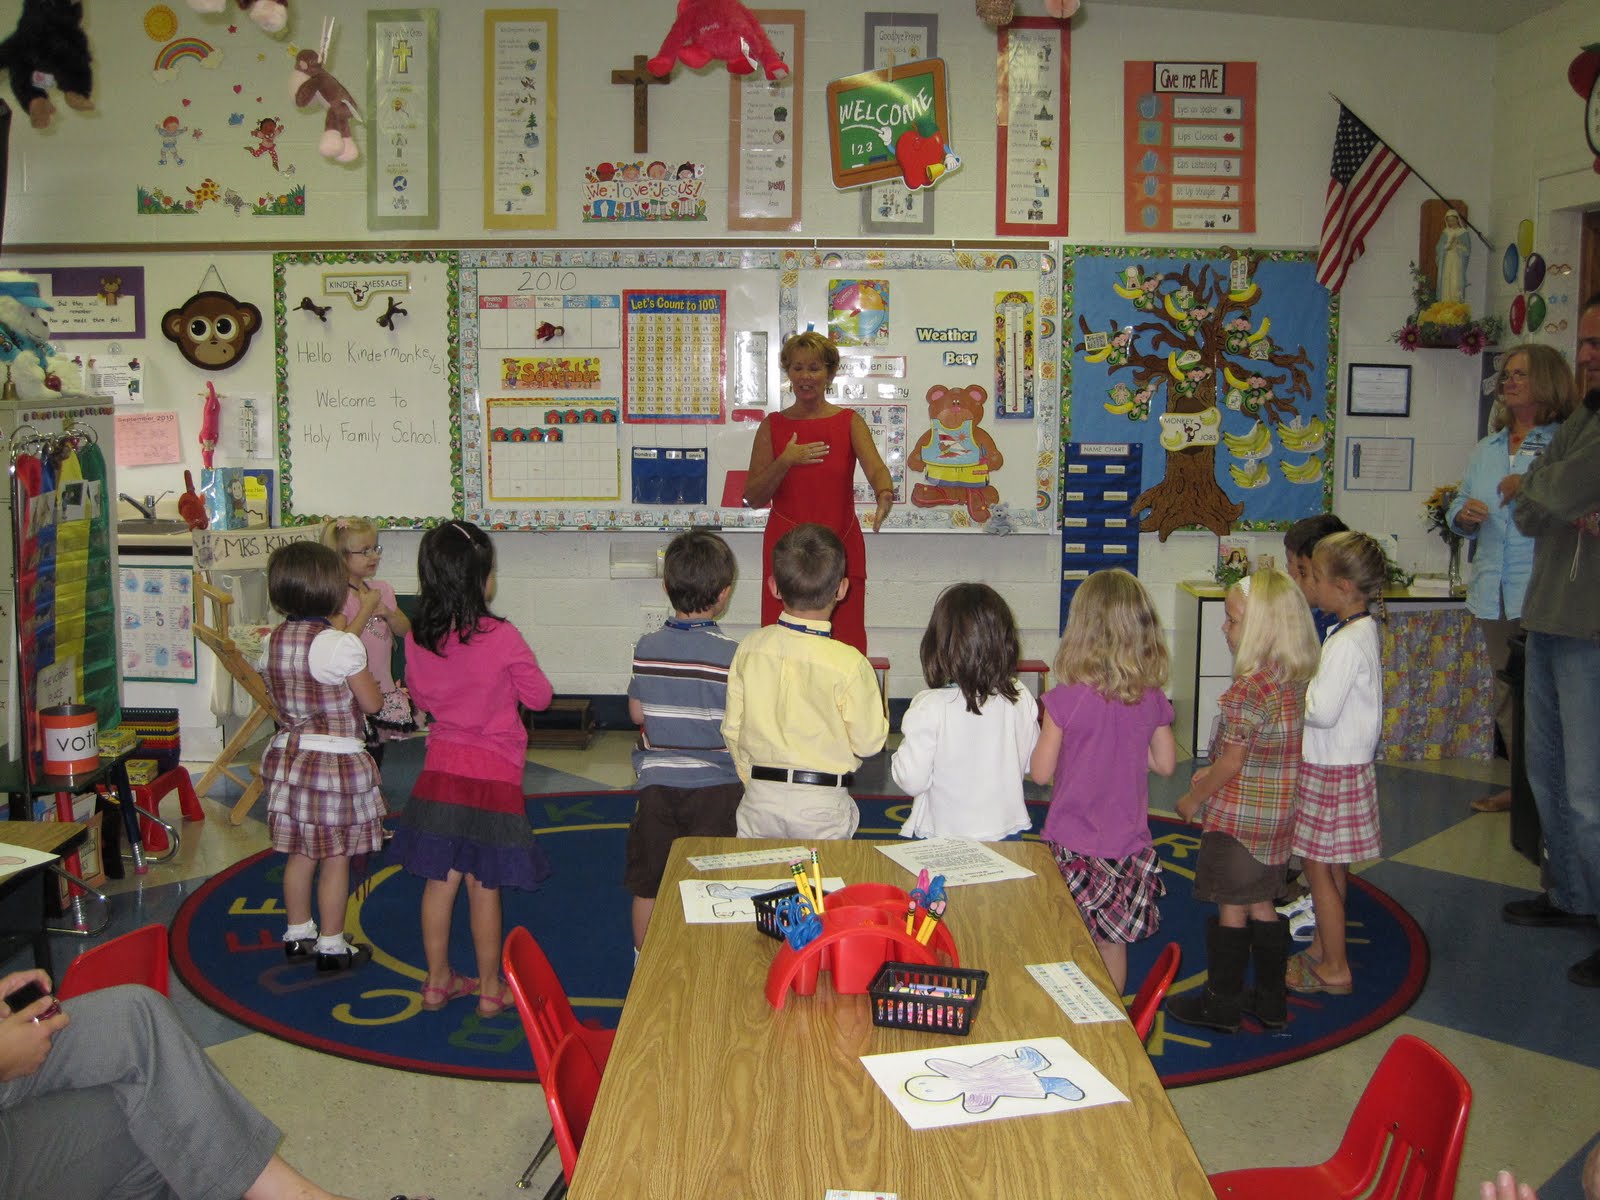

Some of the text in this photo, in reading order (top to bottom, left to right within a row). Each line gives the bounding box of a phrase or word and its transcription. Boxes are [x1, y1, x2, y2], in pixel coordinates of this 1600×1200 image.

[880, 31, 922, 44] Goodbye Prayer
[1160, 68, 1218, 89] Give me FIVE
[839, 86, 933, 126] WELCOME
[1178, 129, 1218, 141] Lips Closed
[1191, 160, 1217, 172] Listening
[586, 181, 703, 199] We love Jesus!
[329, 279, 403, 289] KINDER MESSAGE
[517, 271, 577, 291] 2010
[72, 299, 84, 309] they
[631, 296, 718, 311] Let's Count to 100!
[916, 327, 977, 342] Weather
[297, 340, 447, 381] Hello Kindermonkeys!
[944, 351, 979, 366] Bear
[521, 362, 600, 386] September
[316, 387, 408, 408] Welcome to
[156, 414, 174, 422] 2010
[303, 419, 441, 453] Holy Family School.
[331, 988, 424, 1026] C
